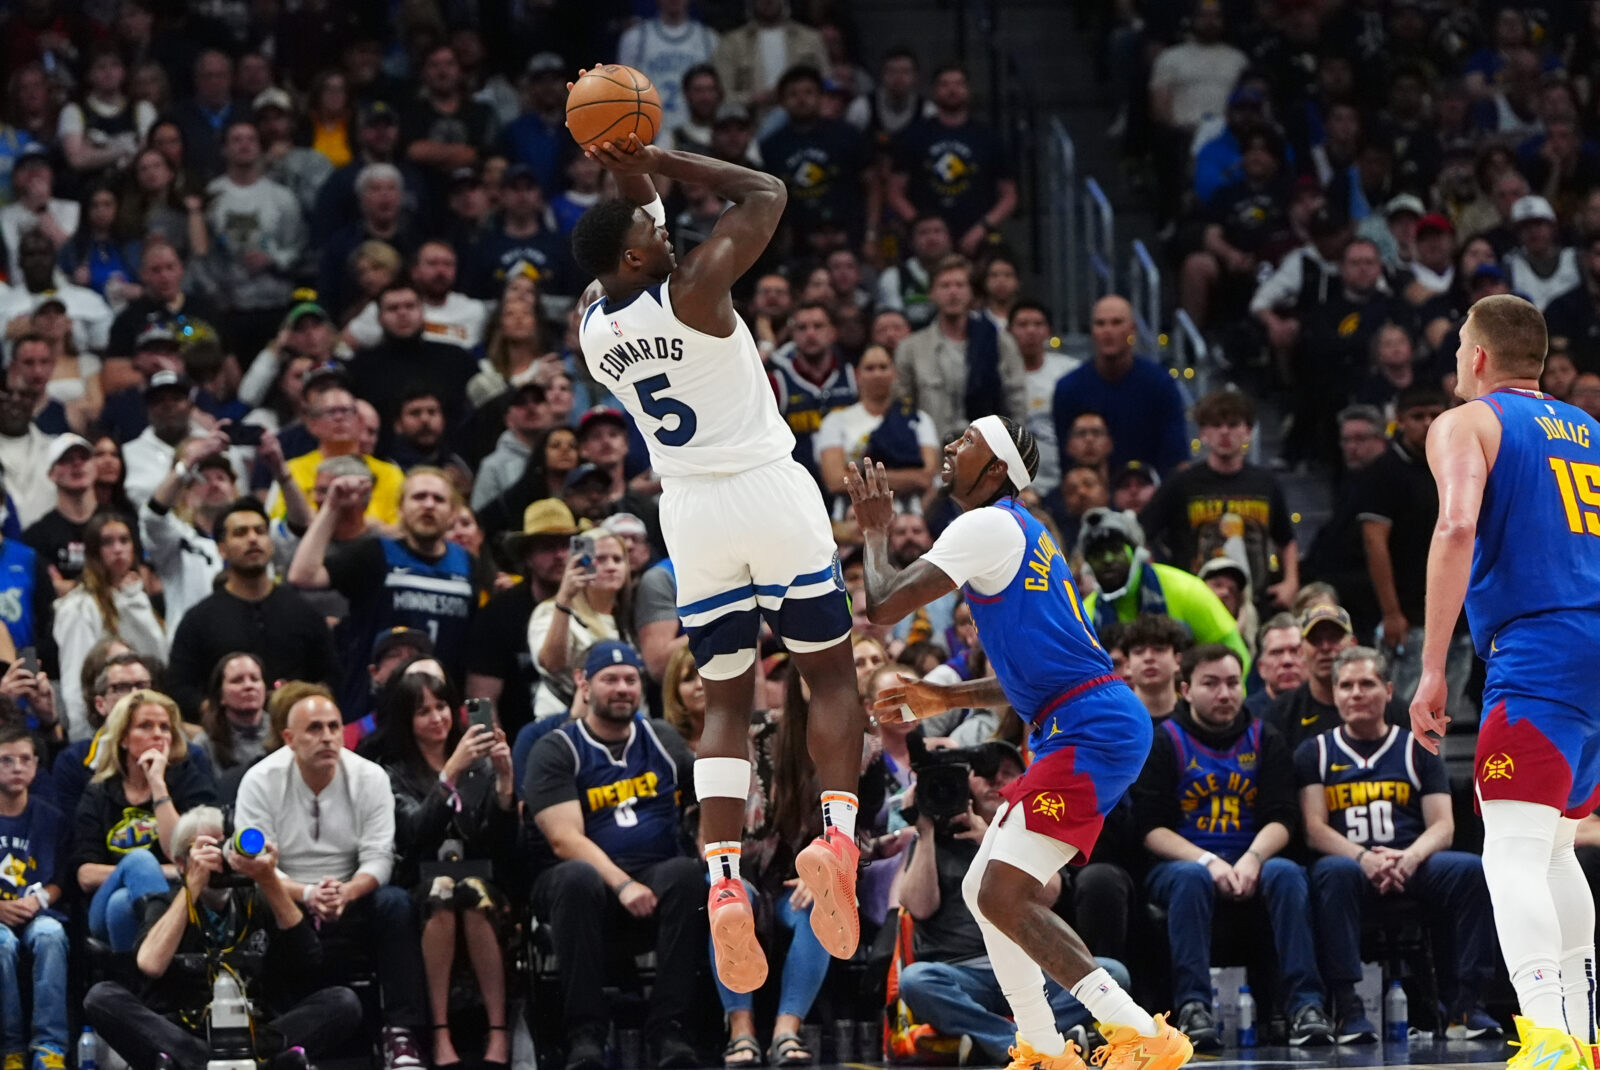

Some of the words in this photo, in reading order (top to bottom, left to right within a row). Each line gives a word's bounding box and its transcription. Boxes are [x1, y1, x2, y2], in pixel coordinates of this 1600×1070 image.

[599, 336, 684, 382] EDWARDS
[632, 372, 698, 448] 5
[1547, 456, 1600, 538] 15
[1324, 780, 1411, 812] DENVER
[1344, 799, 1396, 844] 50
